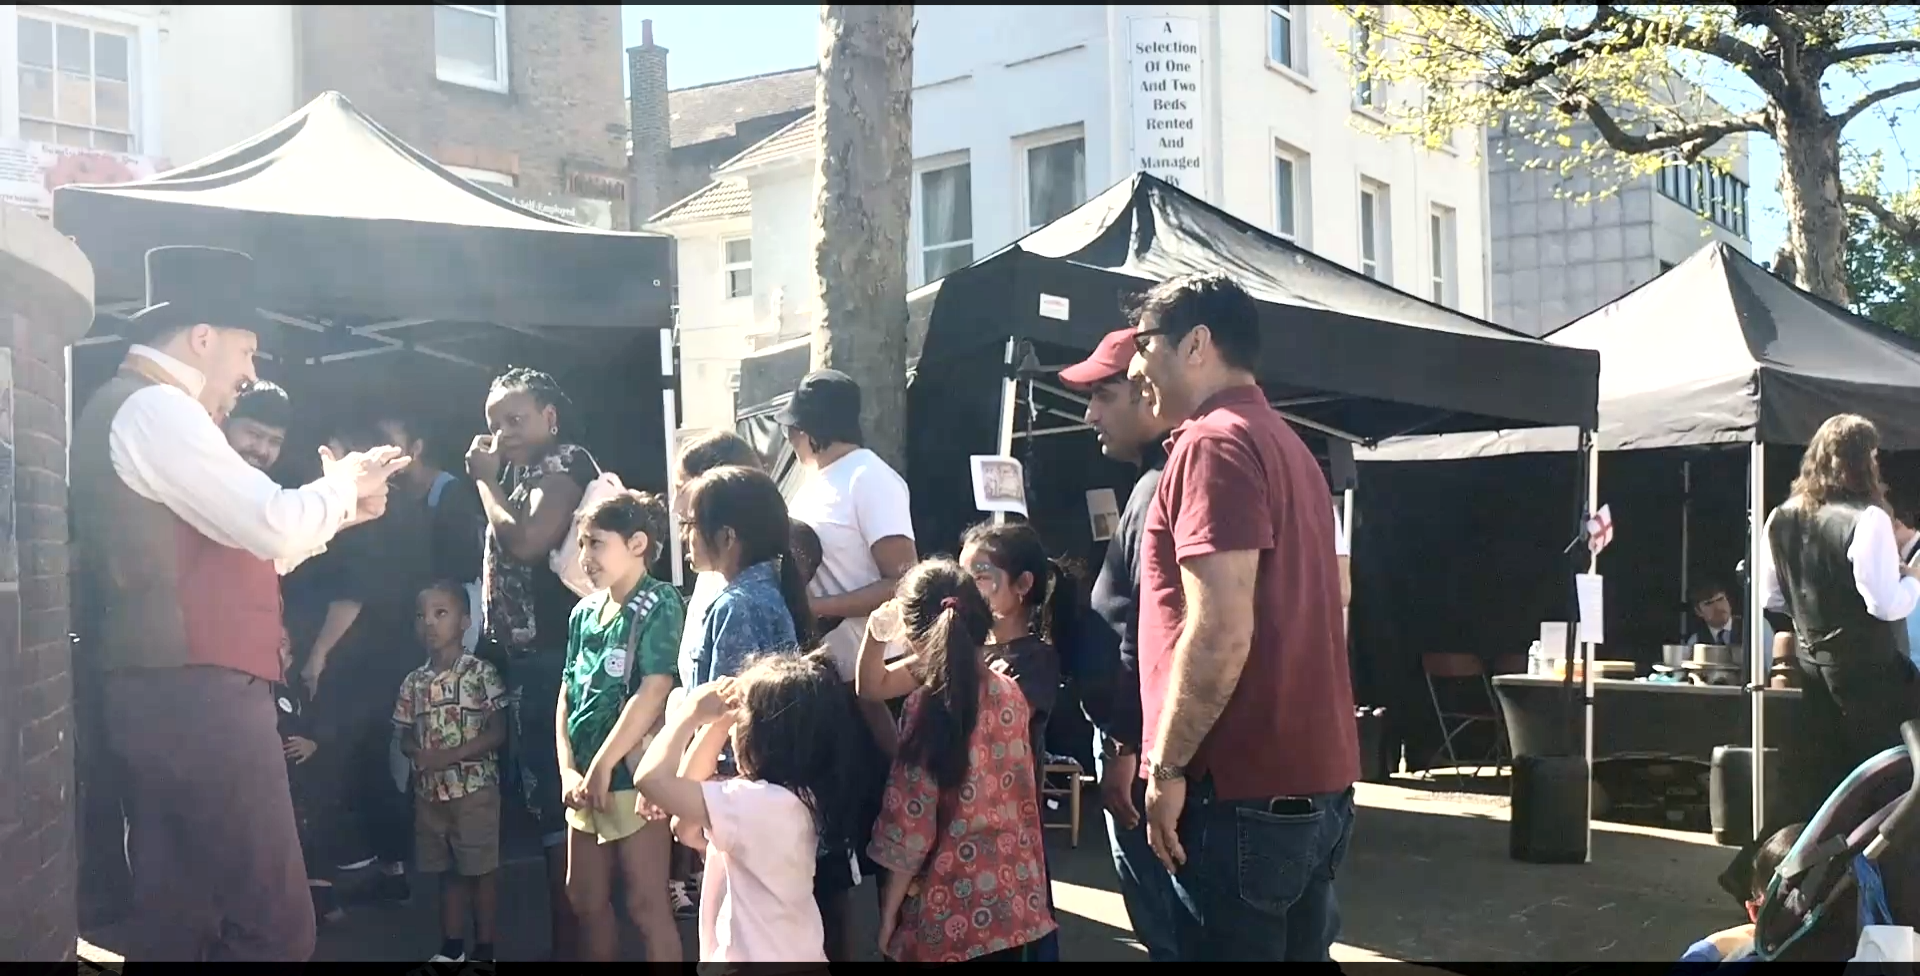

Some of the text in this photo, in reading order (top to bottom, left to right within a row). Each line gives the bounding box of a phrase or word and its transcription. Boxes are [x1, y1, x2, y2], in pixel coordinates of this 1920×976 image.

[1163, 22, 1172, 33] A
[1135, 41, 1197, 54] Selection
[1146, 60, 1191, 73] Of One
[1141, 79, 1196, 92] And Two
[1153, 99, 1187, 110] Beds
[1146, 118, 1193, 130] Rented
[1159, 136, 1184, 148] And
[1140, 156, 1200, 170] Managed
